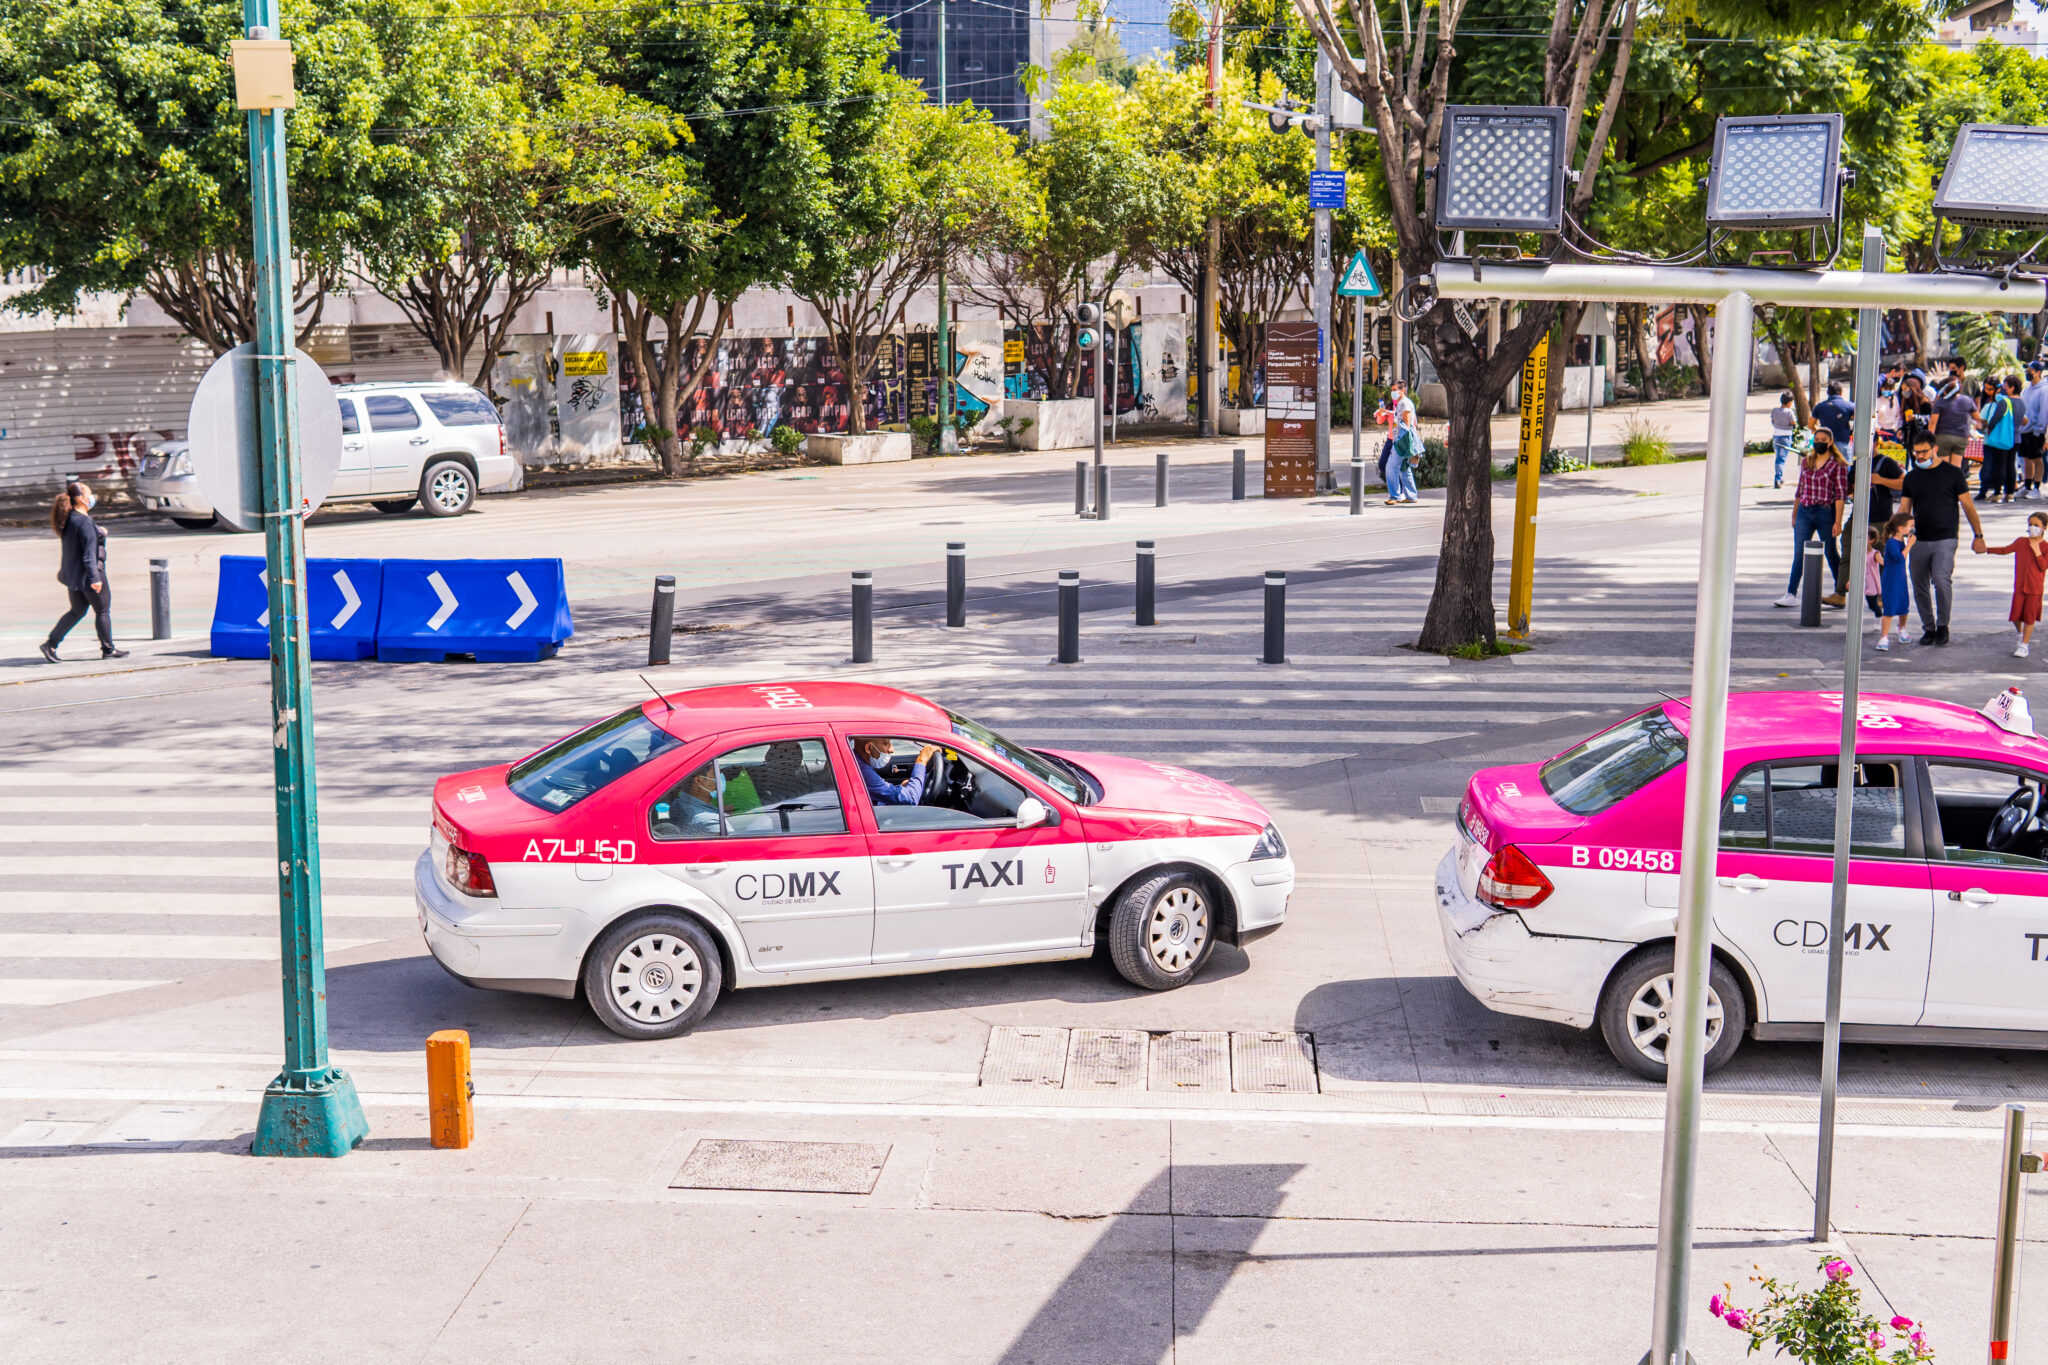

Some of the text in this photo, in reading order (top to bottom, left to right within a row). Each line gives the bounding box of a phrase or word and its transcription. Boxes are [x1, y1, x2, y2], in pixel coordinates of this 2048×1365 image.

[1520, 357, 1536, 466] CONSTRUIR
[1535, 356, 1547, 439] GOLPEAR
[942, 859, 1024, 890] TAXI
[1572, 846, 1675, 872] B 09458
[735, 870, 842, 901] CDMX
[758, 944, 784, 953] aire
[1773, 919, 1892, 952] CDMX
[2024, 933, 2048, 962] T
